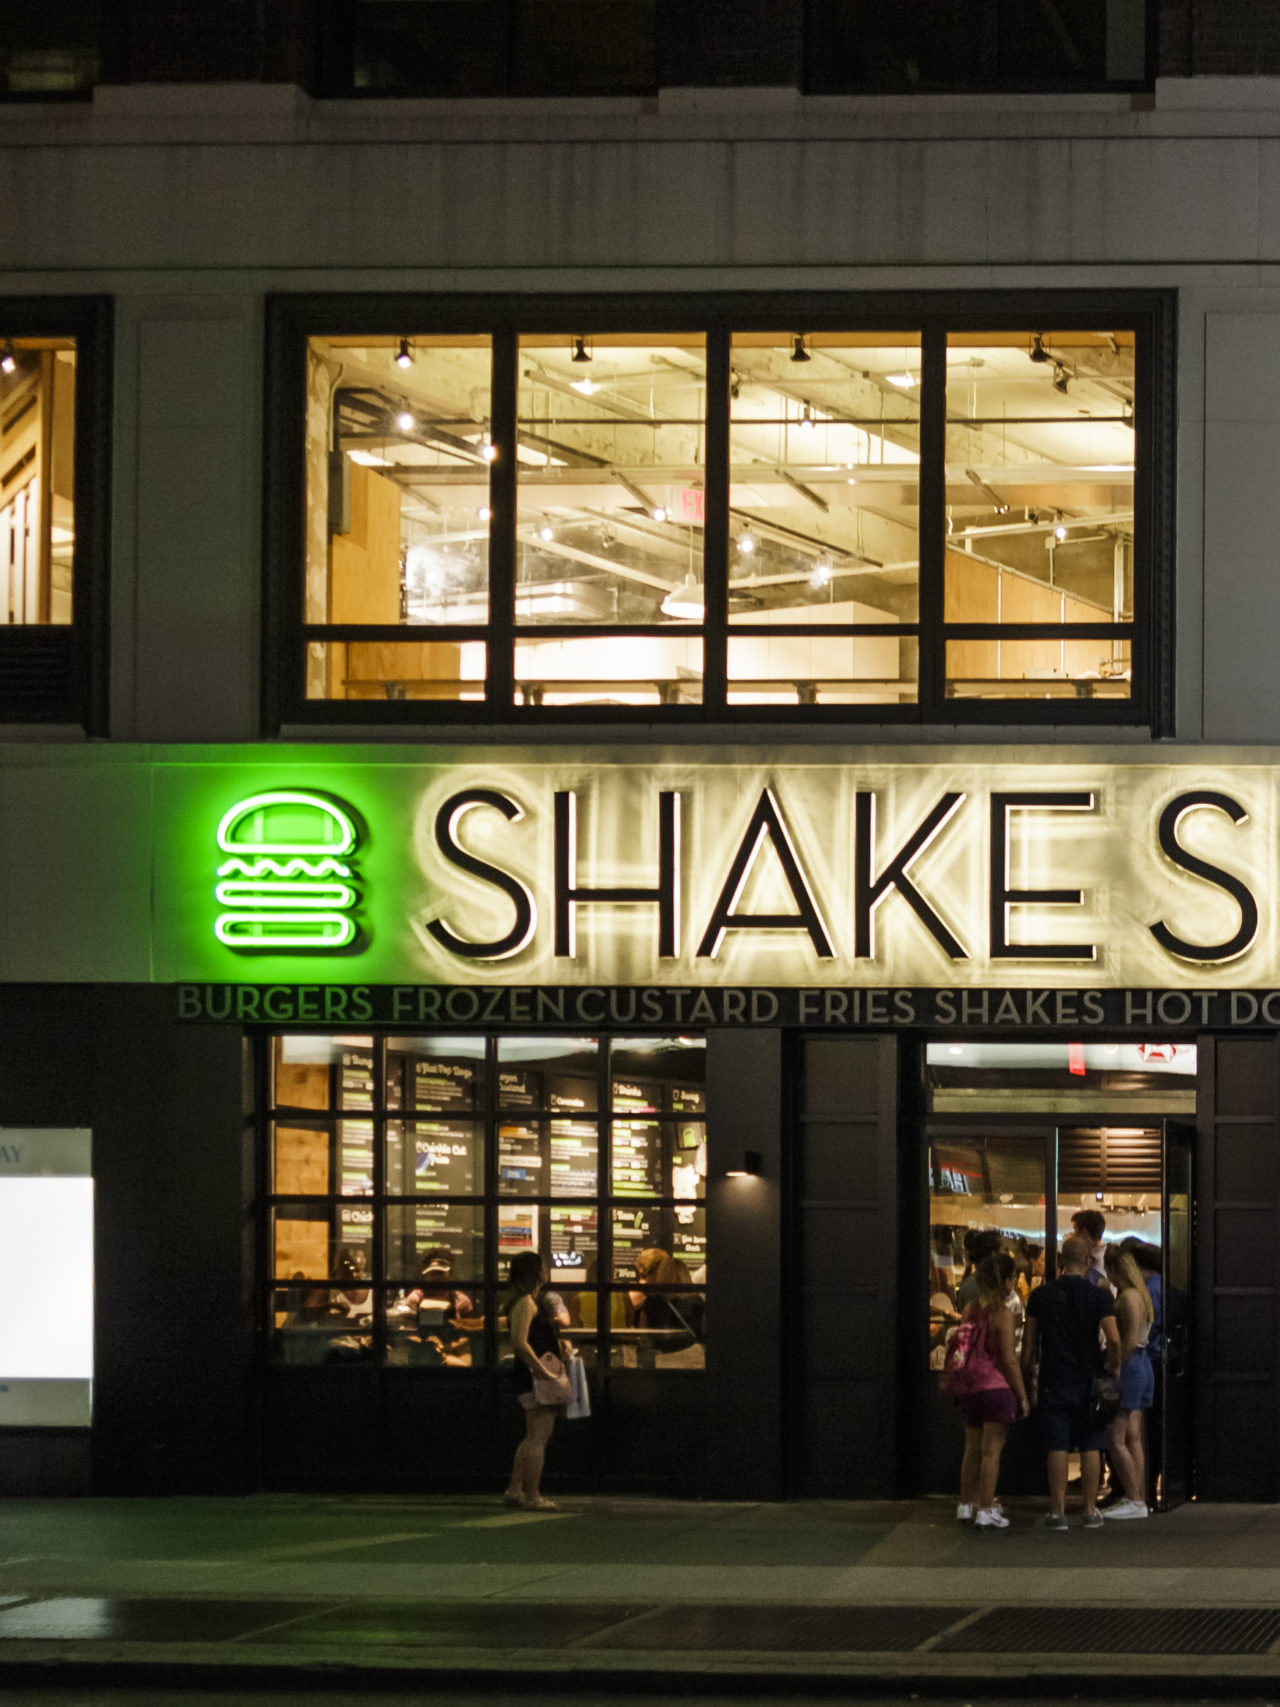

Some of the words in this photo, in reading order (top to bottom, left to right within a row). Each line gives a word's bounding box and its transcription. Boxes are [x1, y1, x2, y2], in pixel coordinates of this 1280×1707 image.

[425, 786, 1096, 960] SHAKE
[178, 986, 372, 1021] BURGERS
[392, 987, 564, 1021] FROZEN
[577, 987, 779, 1022] CUSTARD
[800, 990, 915, 1024] FRIES
[934, 990, 1105, 1024] SHAKES
[1125, 991, 1218, 1025] HOT
